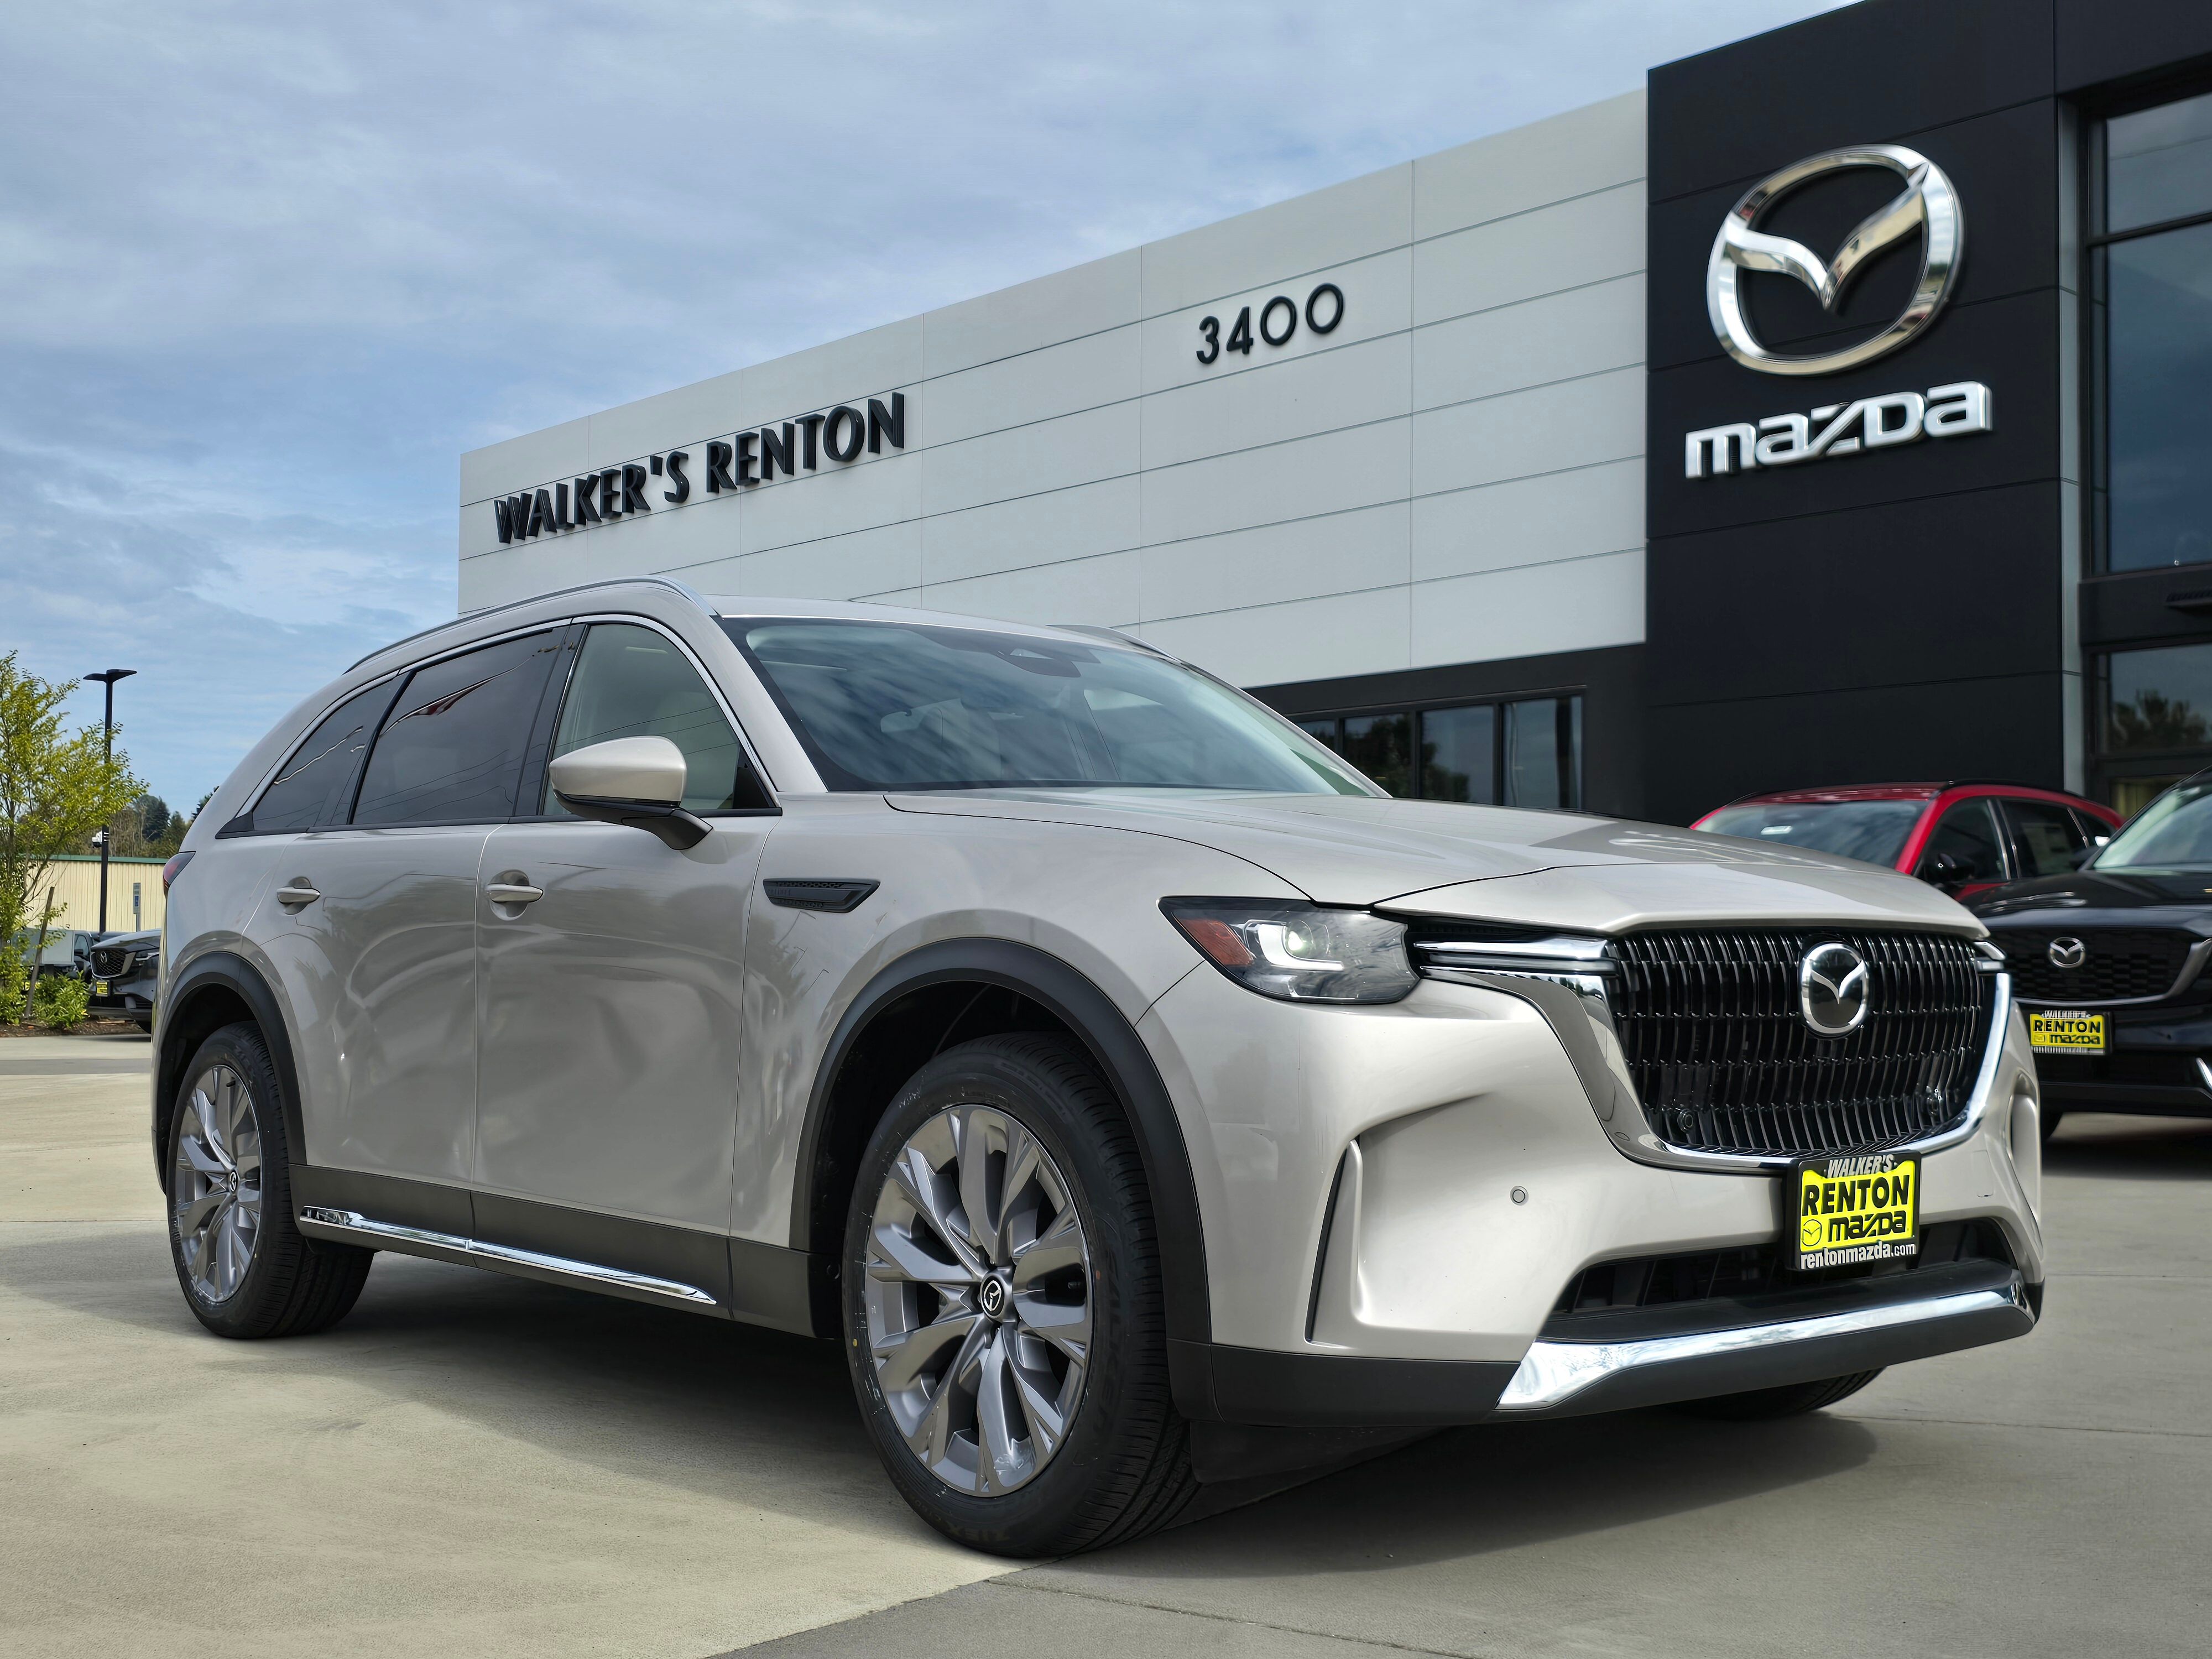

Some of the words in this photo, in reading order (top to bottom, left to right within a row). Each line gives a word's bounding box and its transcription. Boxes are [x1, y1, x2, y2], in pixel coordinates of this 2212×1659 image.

[1196, 282, 1344, 365] 3400
[493, 451, 690, 544] WALKER'S
[706, 392, 905, 493] RENTON
[2034, 1020, 2101, 1034] RENTON
[1827, 1154, 1895, 1179] WALKER'S
[1802, 1175, 1910, 1217] RENTON
[1800, 1241, 1917, 1270] rentonmazda.com
